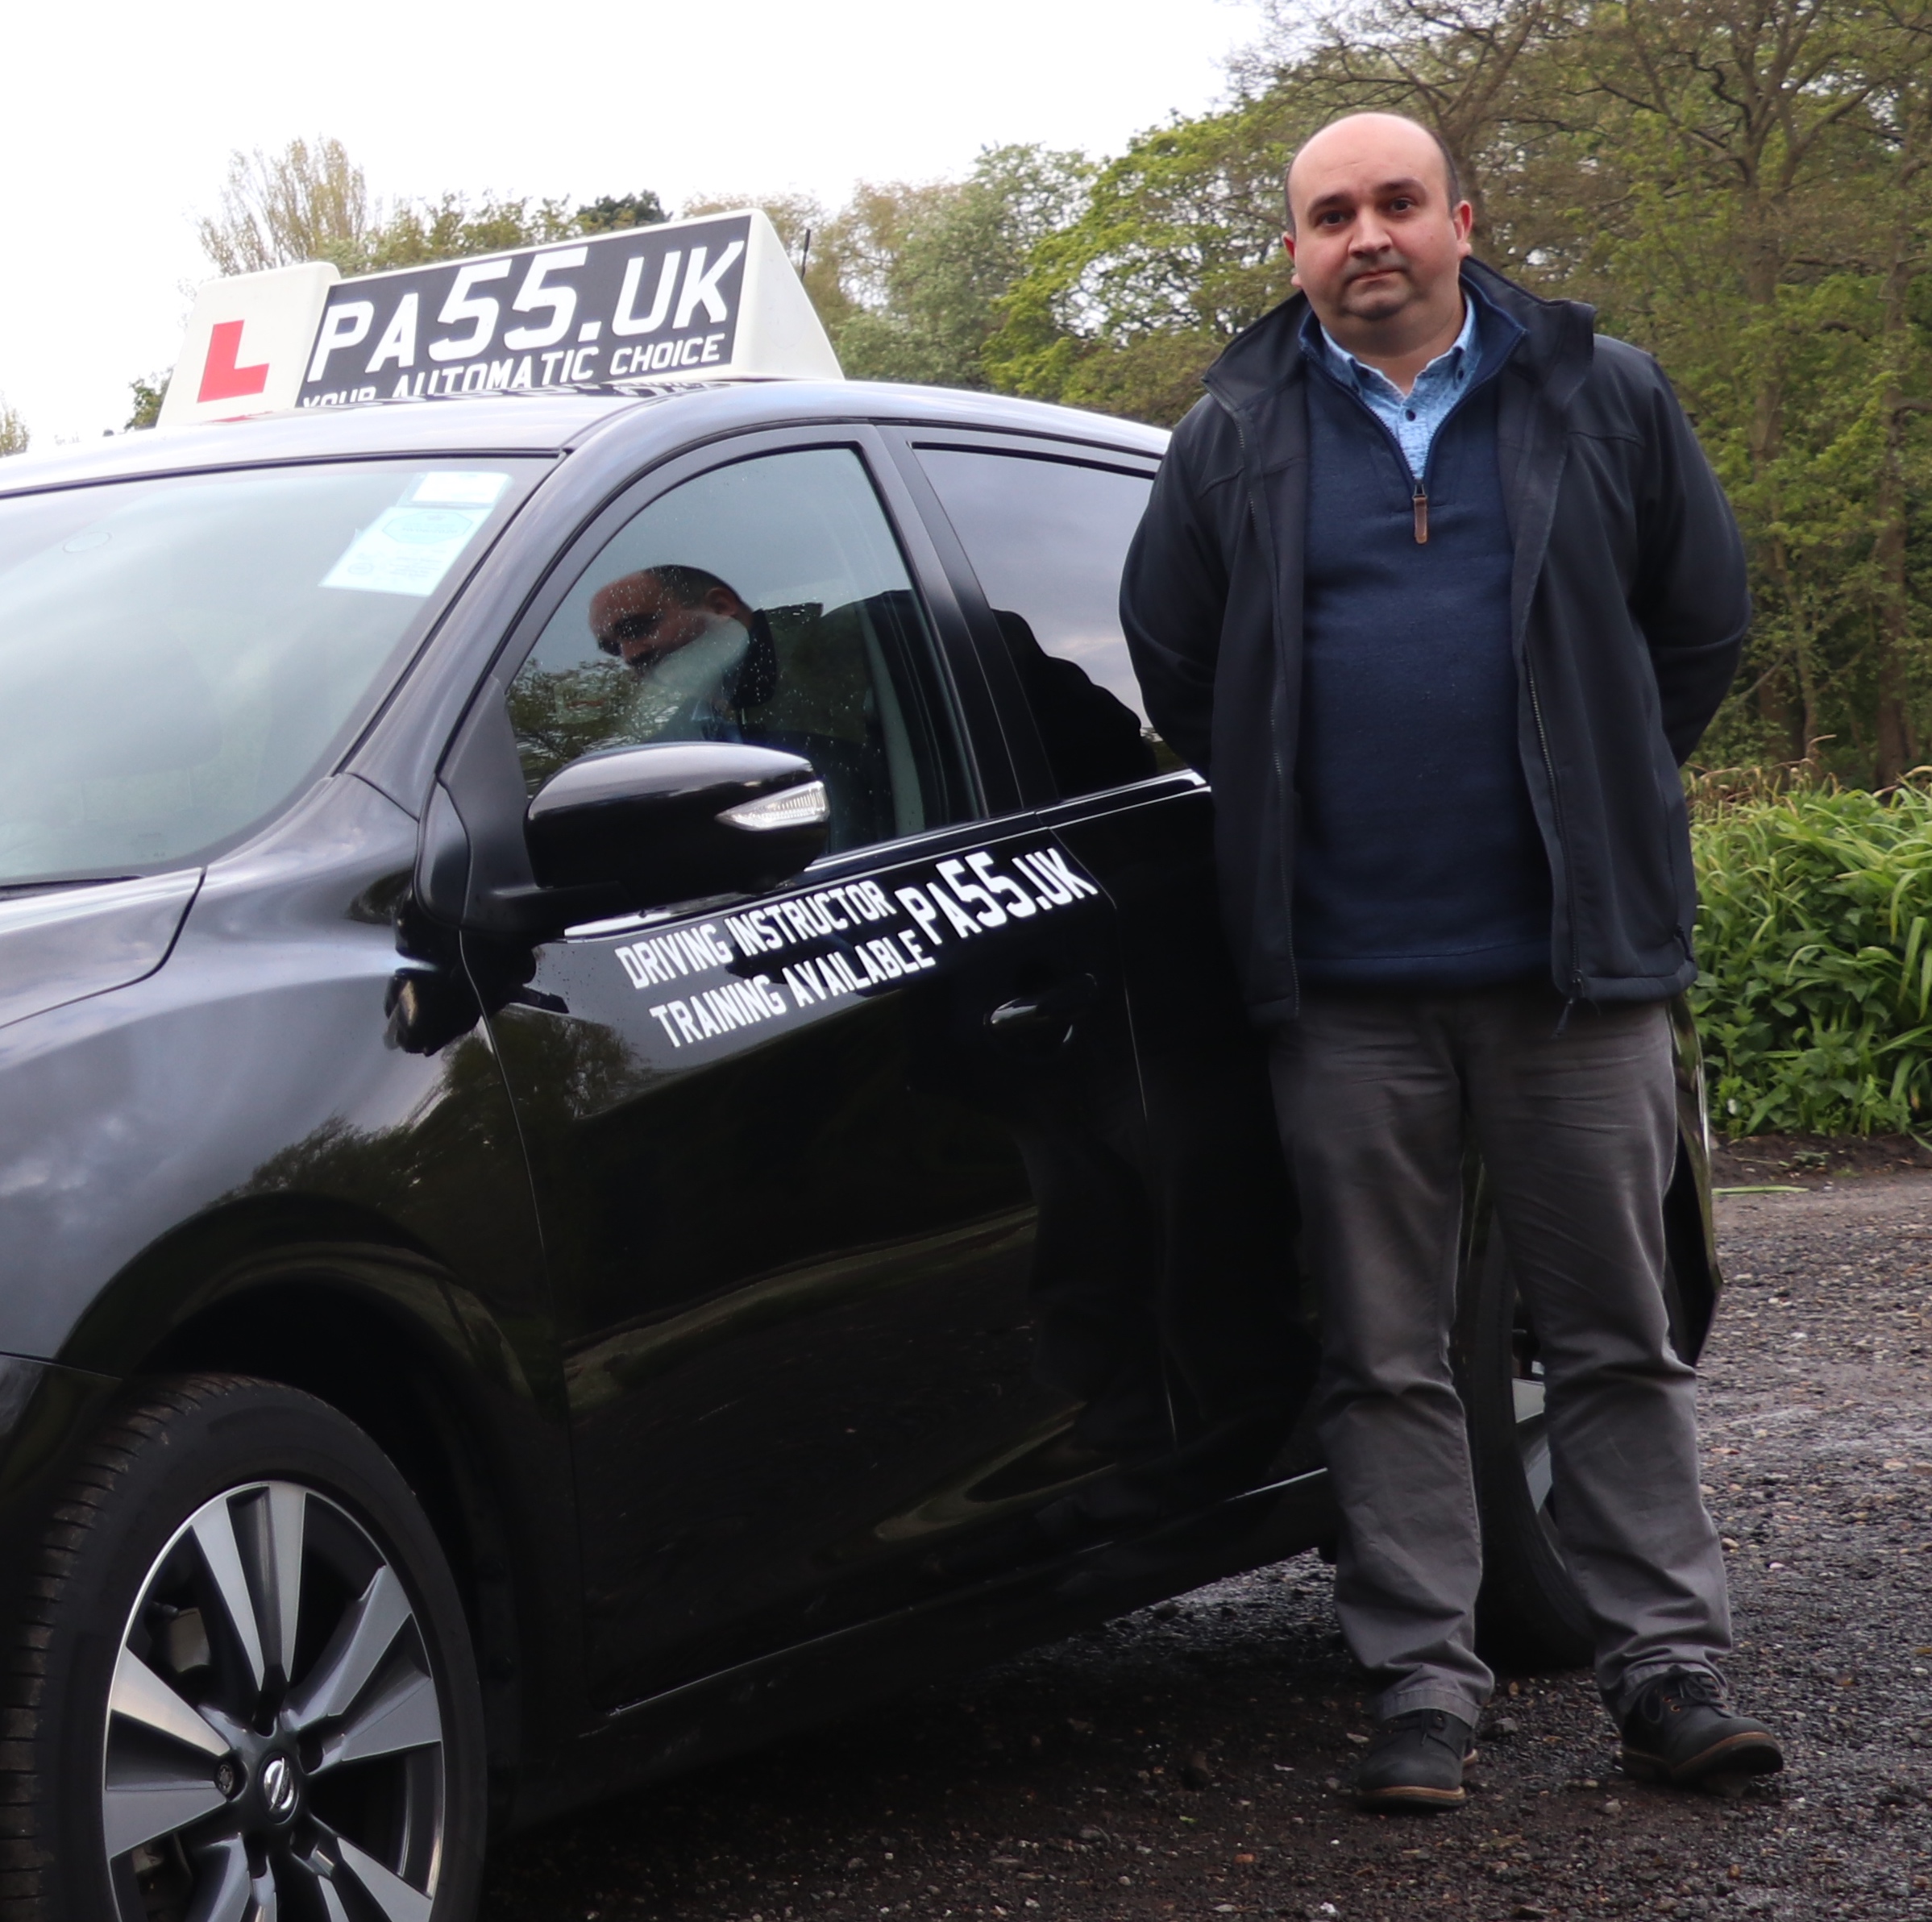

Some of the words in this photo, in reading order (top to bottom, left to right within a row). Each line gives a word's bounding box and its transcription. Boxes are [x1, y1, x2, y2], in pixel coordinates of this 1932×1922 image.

[198, 320, 269, 402] L
[306, 239, 746, 383] PA55.UK
[392, 346, 600, 400] AUTOMATIC
[609, 333, 725, 376] CHOICE
[615, 923, 734, 990] DRIVING
[724, 880, 897, 957] INSTRUCTOR
[894, 848, 1099, 946] PA55.UK
[650, 973, 787, 1048] TRAINING
[782, 929, 937, 1008] AVAILABLE
